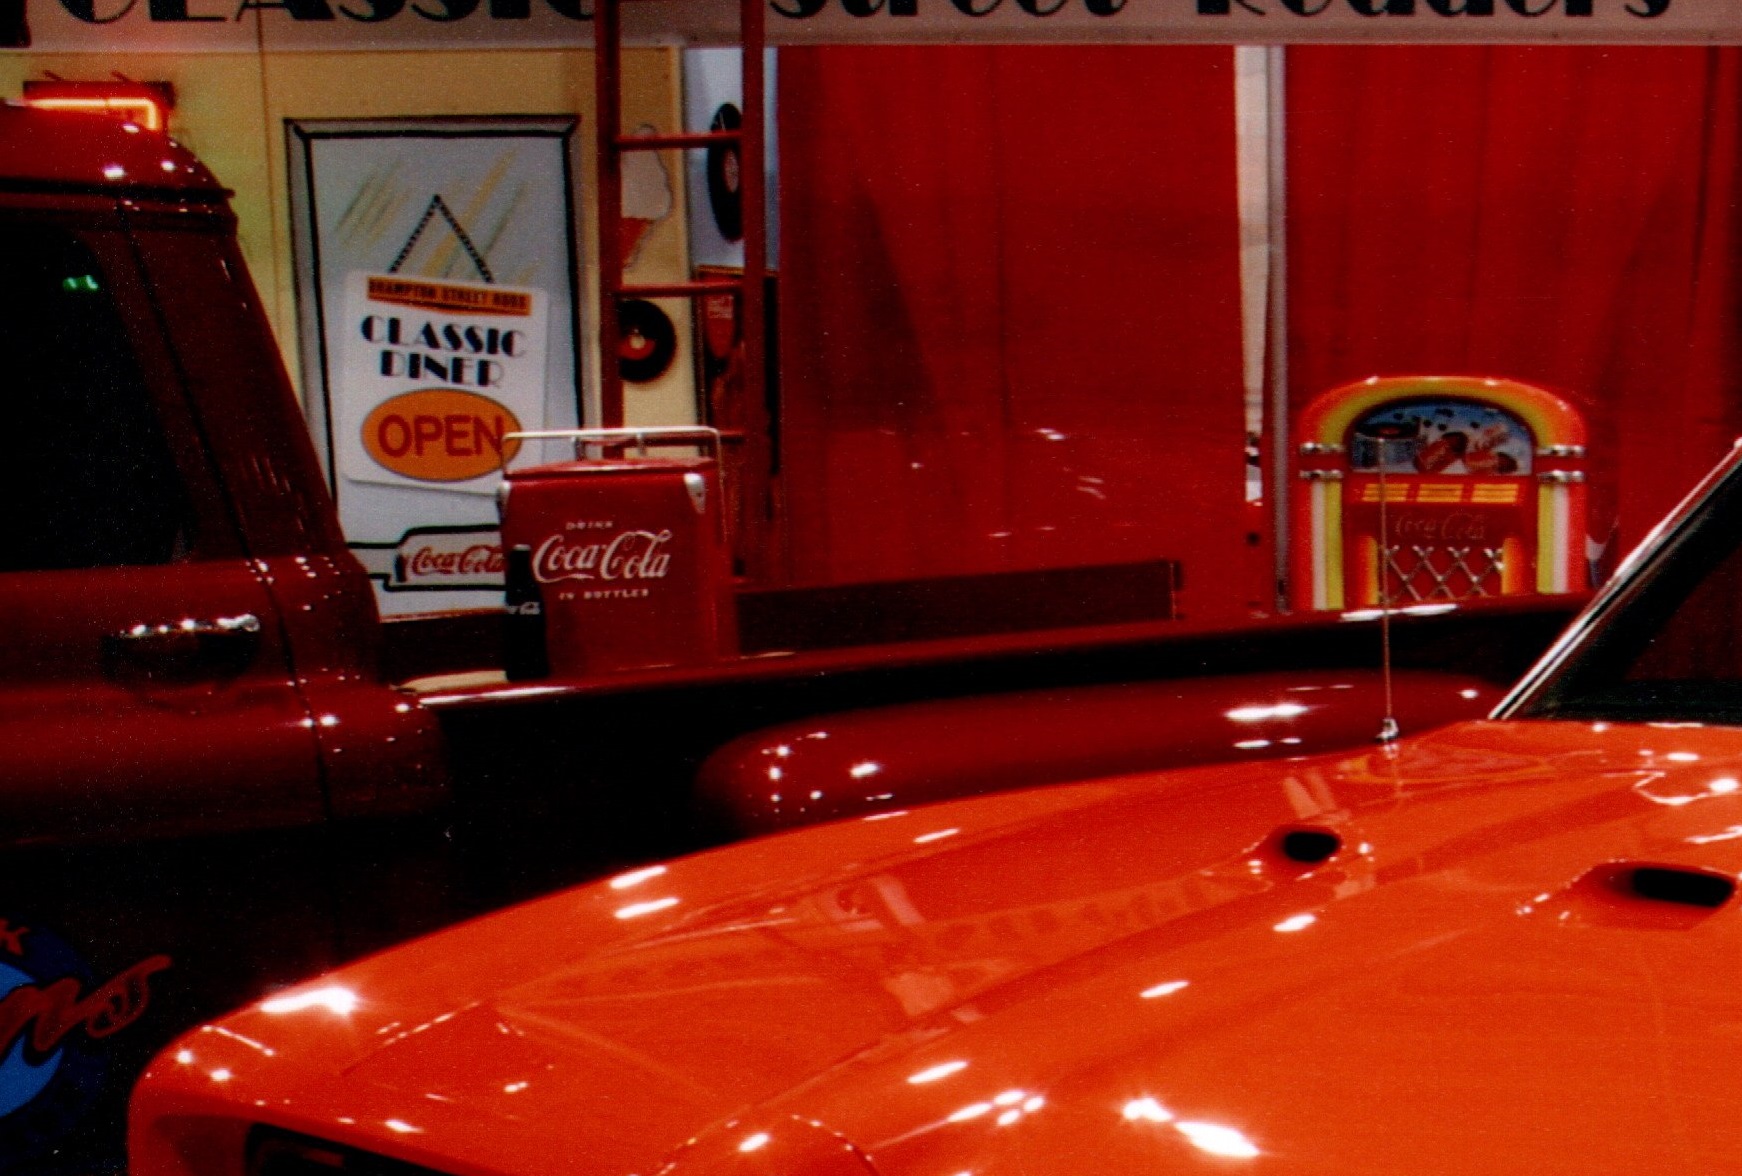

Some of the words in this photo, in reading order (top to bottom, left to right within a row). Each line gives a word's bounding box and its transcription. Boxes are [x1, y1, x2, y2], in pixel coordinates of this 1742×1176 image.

[359, 315, 527, 358] CLASSIC
[380, 349, 506, 389] DINER
[378, 413, 505, 459] OPEN
